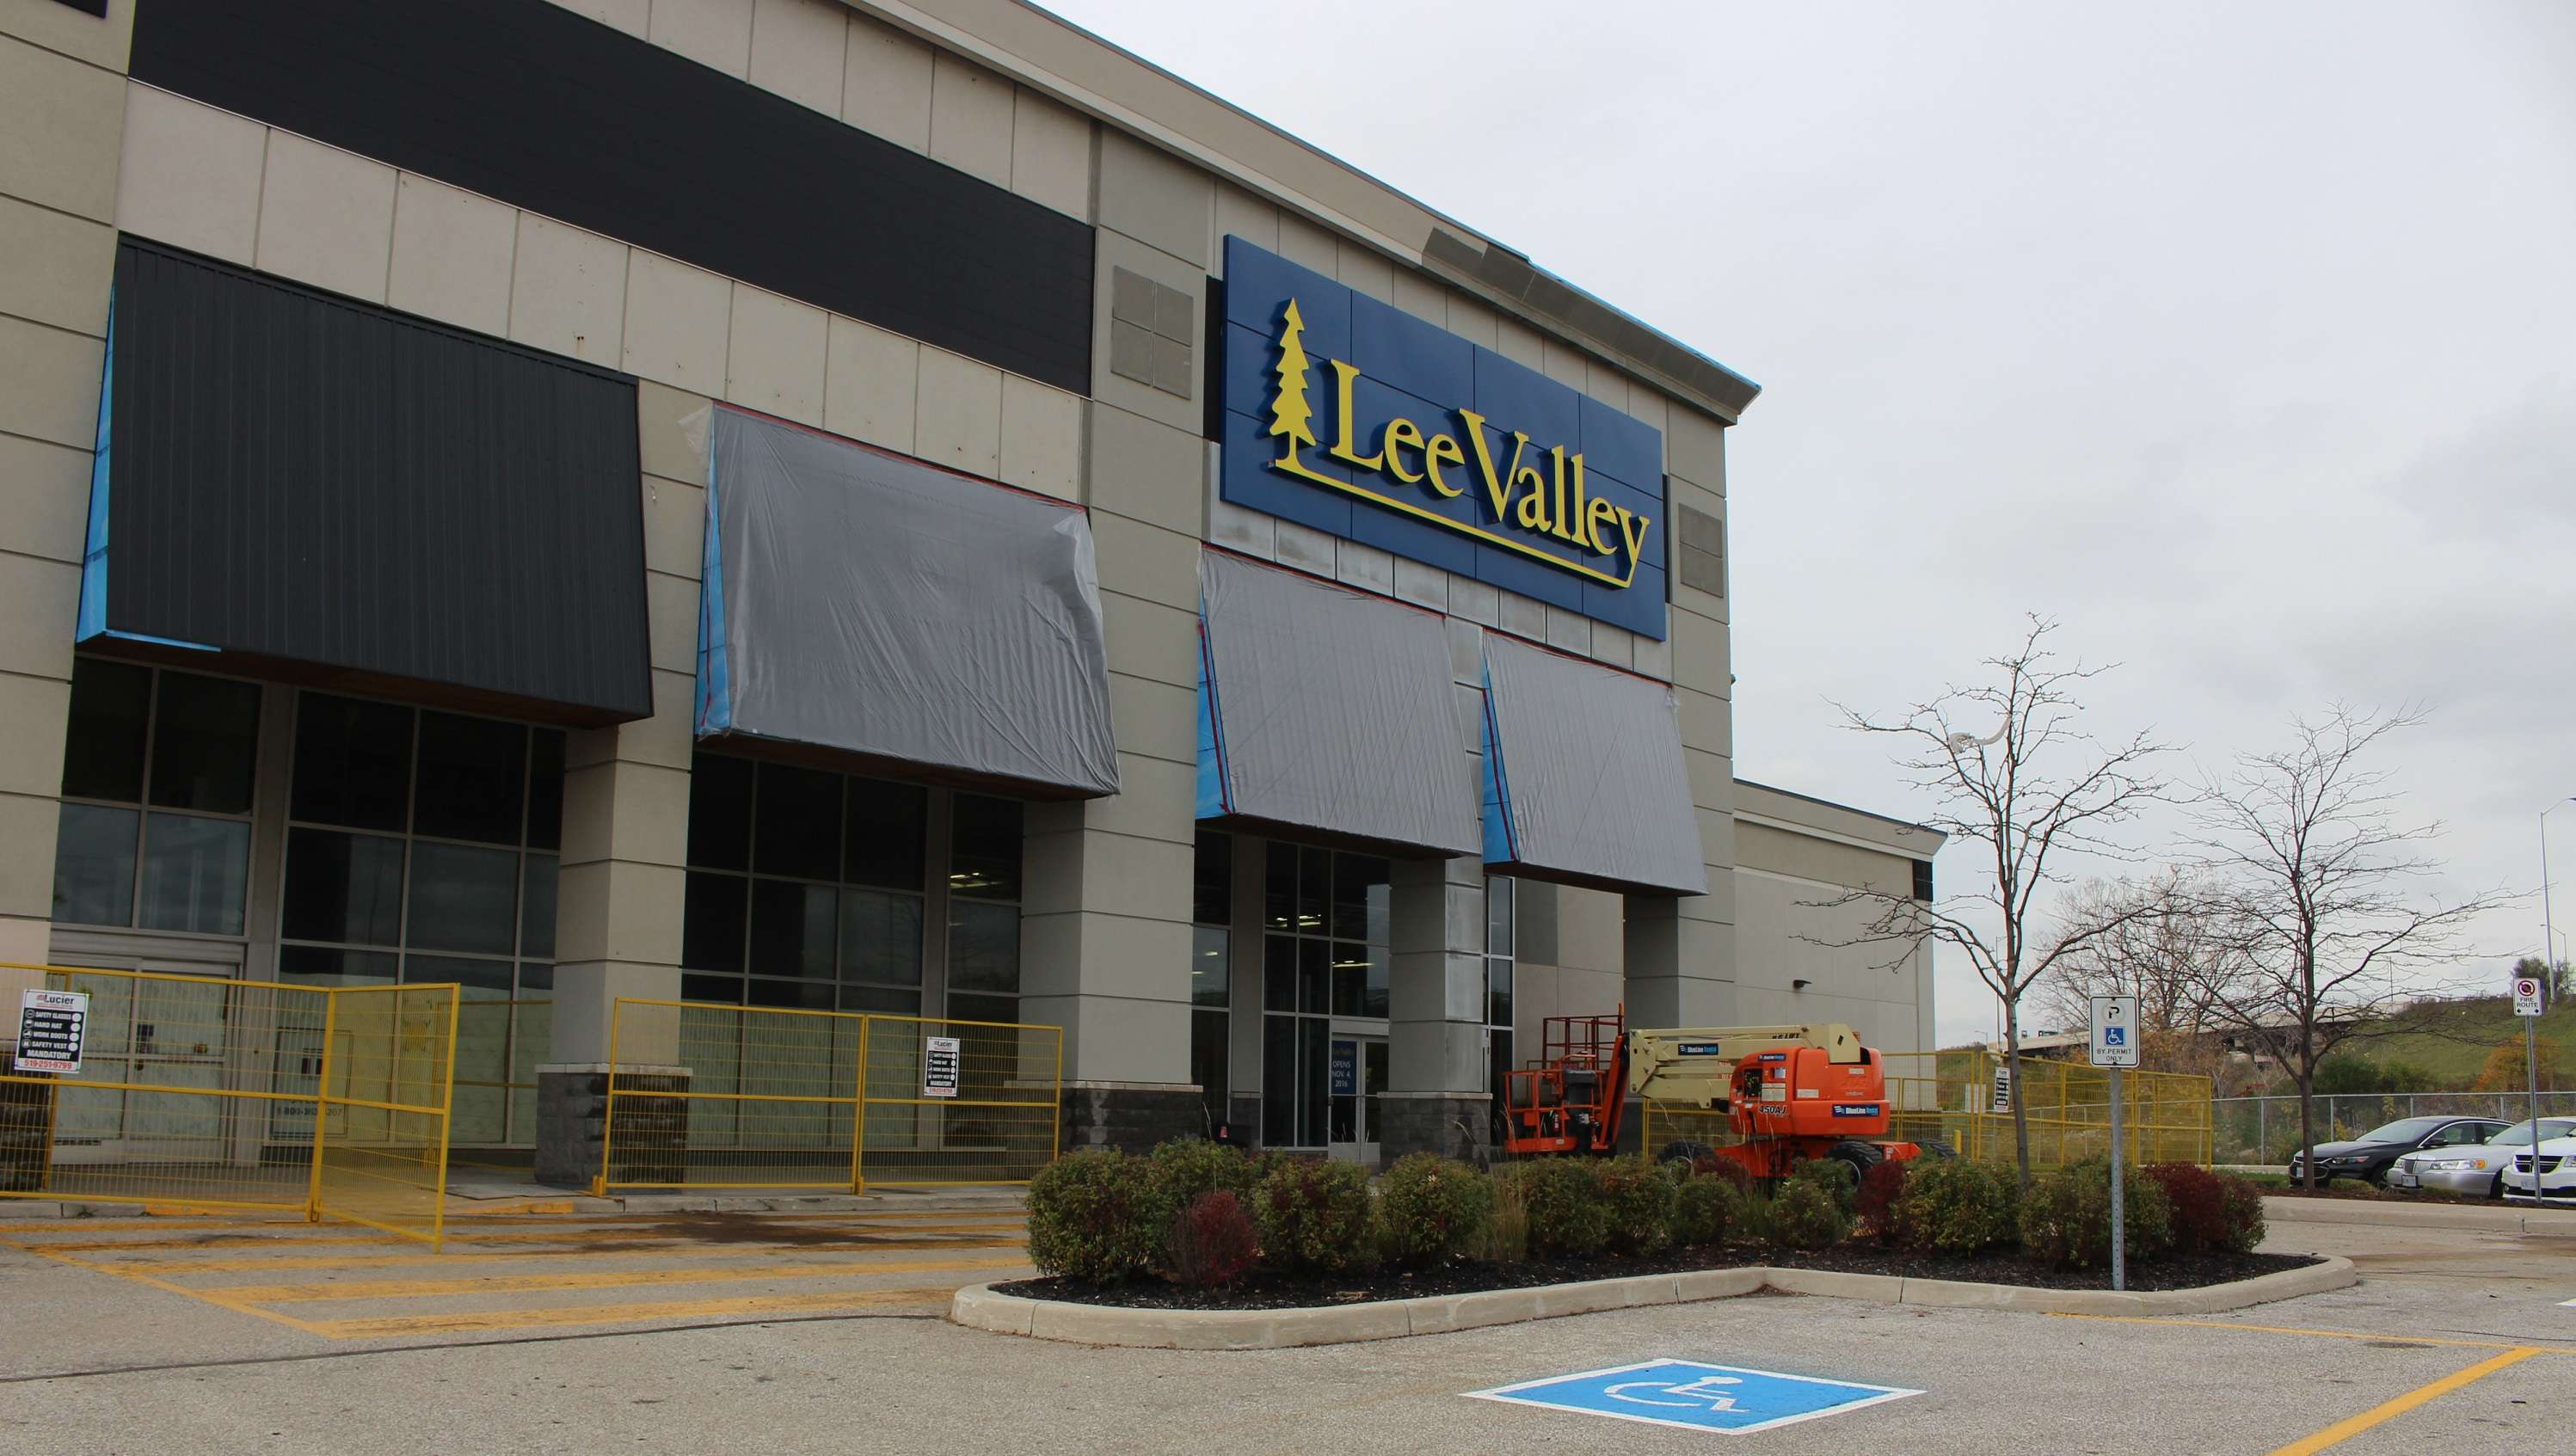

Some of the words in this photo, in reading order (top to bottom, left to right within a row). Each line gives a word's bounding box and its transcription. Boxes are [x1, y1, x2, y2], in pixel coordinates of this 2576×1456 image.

[1330, 358, 1466, 498] Lee
[1460, 408, 1650, 588] Valley
[44, 994, 75, 1004] Lucier
[2108, 1006, 2120, 1019] P
[27, 1050, 71, 1059] MANDATORY
[24, 1060, 72, 1069] 519-251-9799
[1335, 1079, 1348, 1088] 2016
[1759, 1104, 1787, 1115] 450AJ
